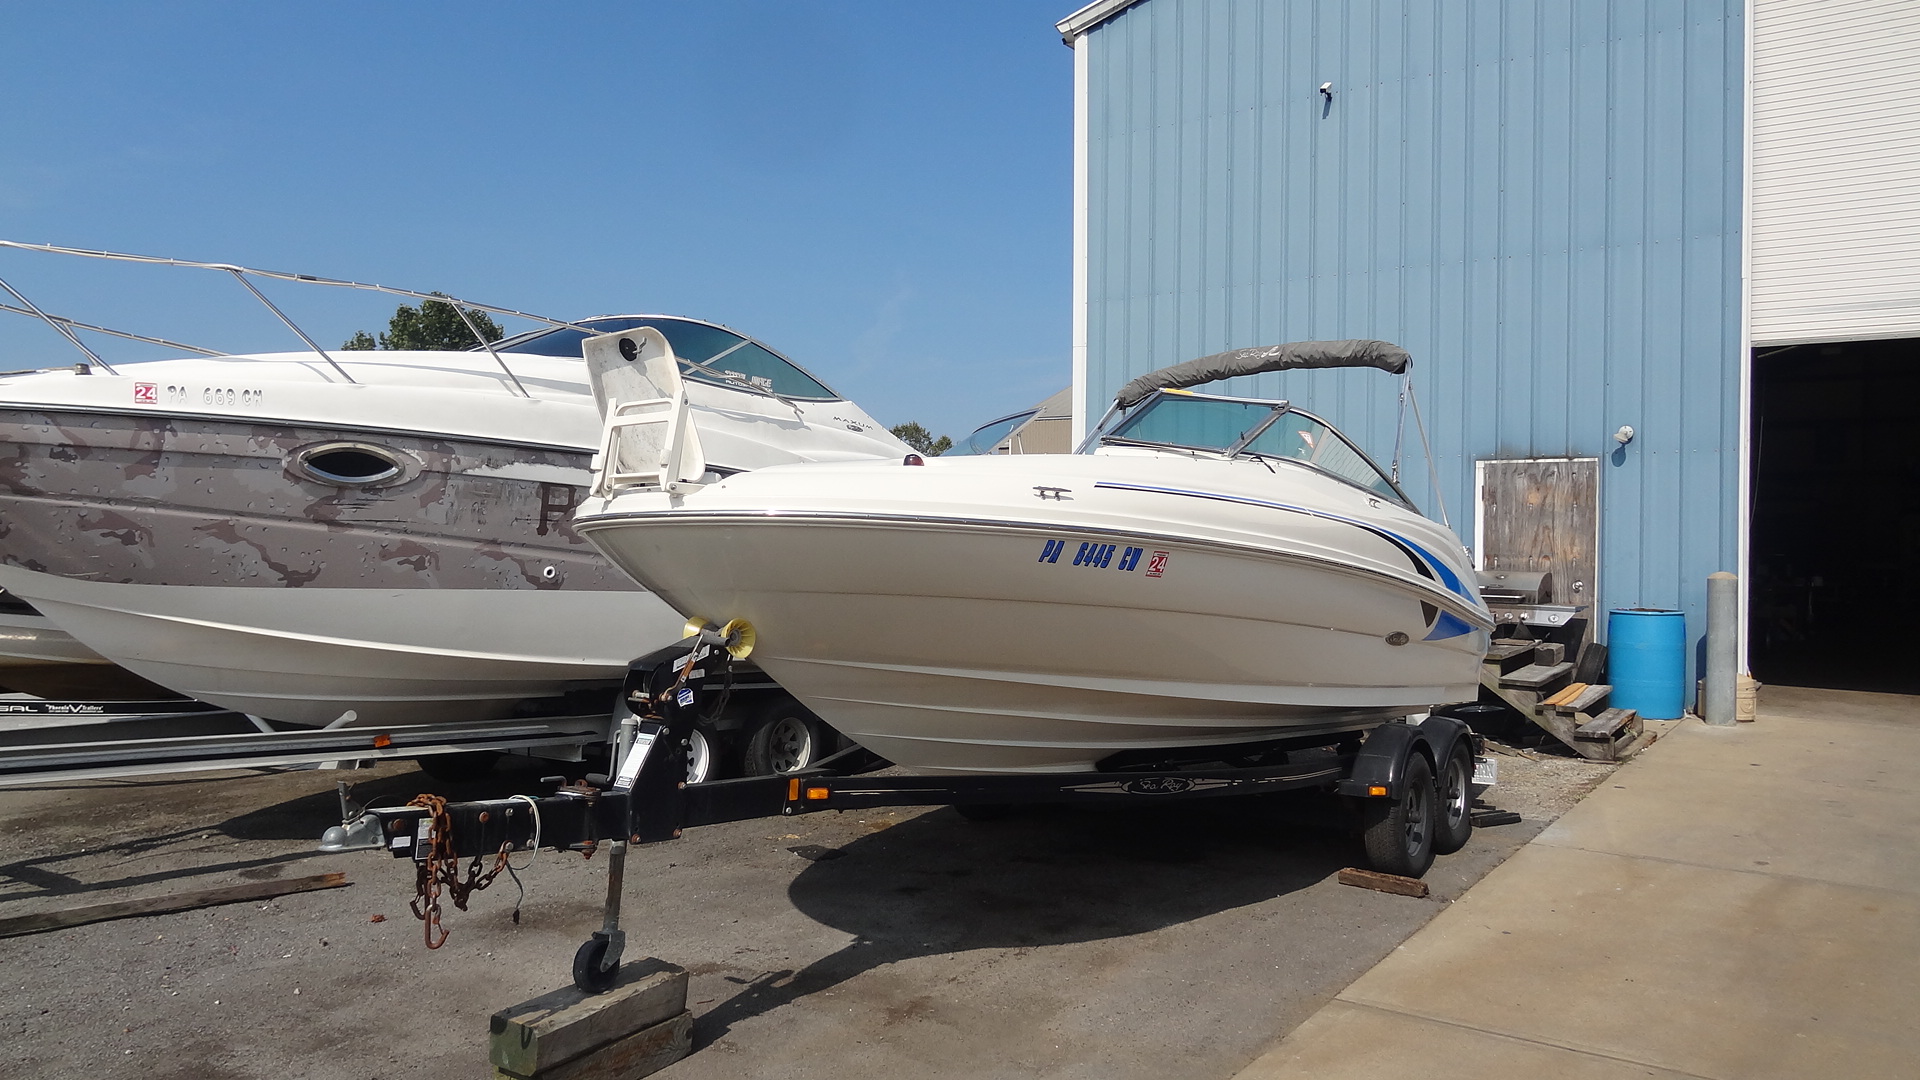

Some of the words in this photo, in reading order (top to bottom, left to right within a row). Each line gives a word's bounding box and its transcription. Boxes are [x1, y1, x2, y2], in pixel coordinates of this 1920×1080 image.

[136, 386, 157, 400] 24
[167, 385, 188, 404] PA
[202, 387, 236, 405] 669
[832, 416, 874, 431] MAXUM
[1038, 540, 1065, 563] PA
[1073, 542, 1116, 569] 6445
[1148, 556, 1168, 573] 24
[1160, 777, 1184, 792] Ray
